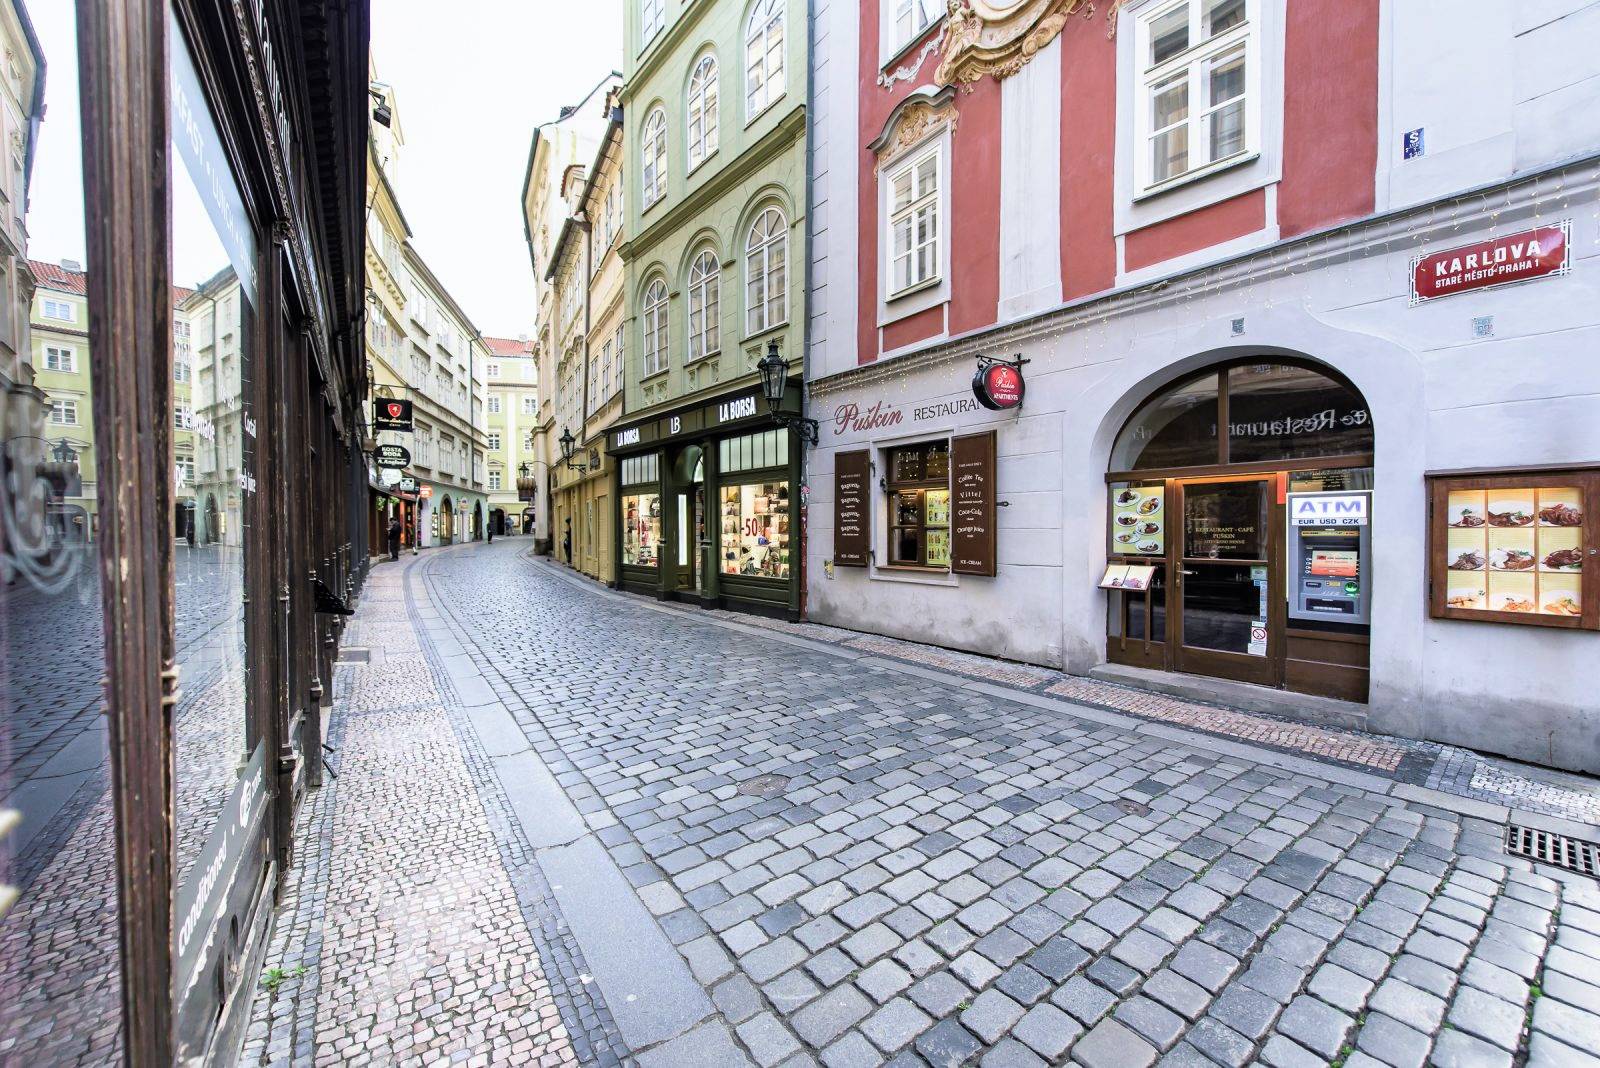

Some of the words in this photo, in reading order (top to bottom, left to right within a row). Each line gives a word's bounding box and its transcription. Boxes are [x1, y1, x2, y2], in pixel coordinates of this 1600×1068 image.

[1436, 240, 1541, 276] KARLOVA
[1435, 271, 1462, 289] STARÉ
[1534, 258, 1540, 268] 1
[719, 404, 729, 423] LA
[729, 397, 756, 419] BORSA
[833, 400, 903, 436] Puškin
[913, 398, 981, 421] RESTAURA
[617, 432, 624, 447] LA
[623, 427, 640, 445] BORSA
[670, 416, 681, 435] LB
[1298, 501, 1362, 514] ATM
[179, 829, 228, 957] conditioned
